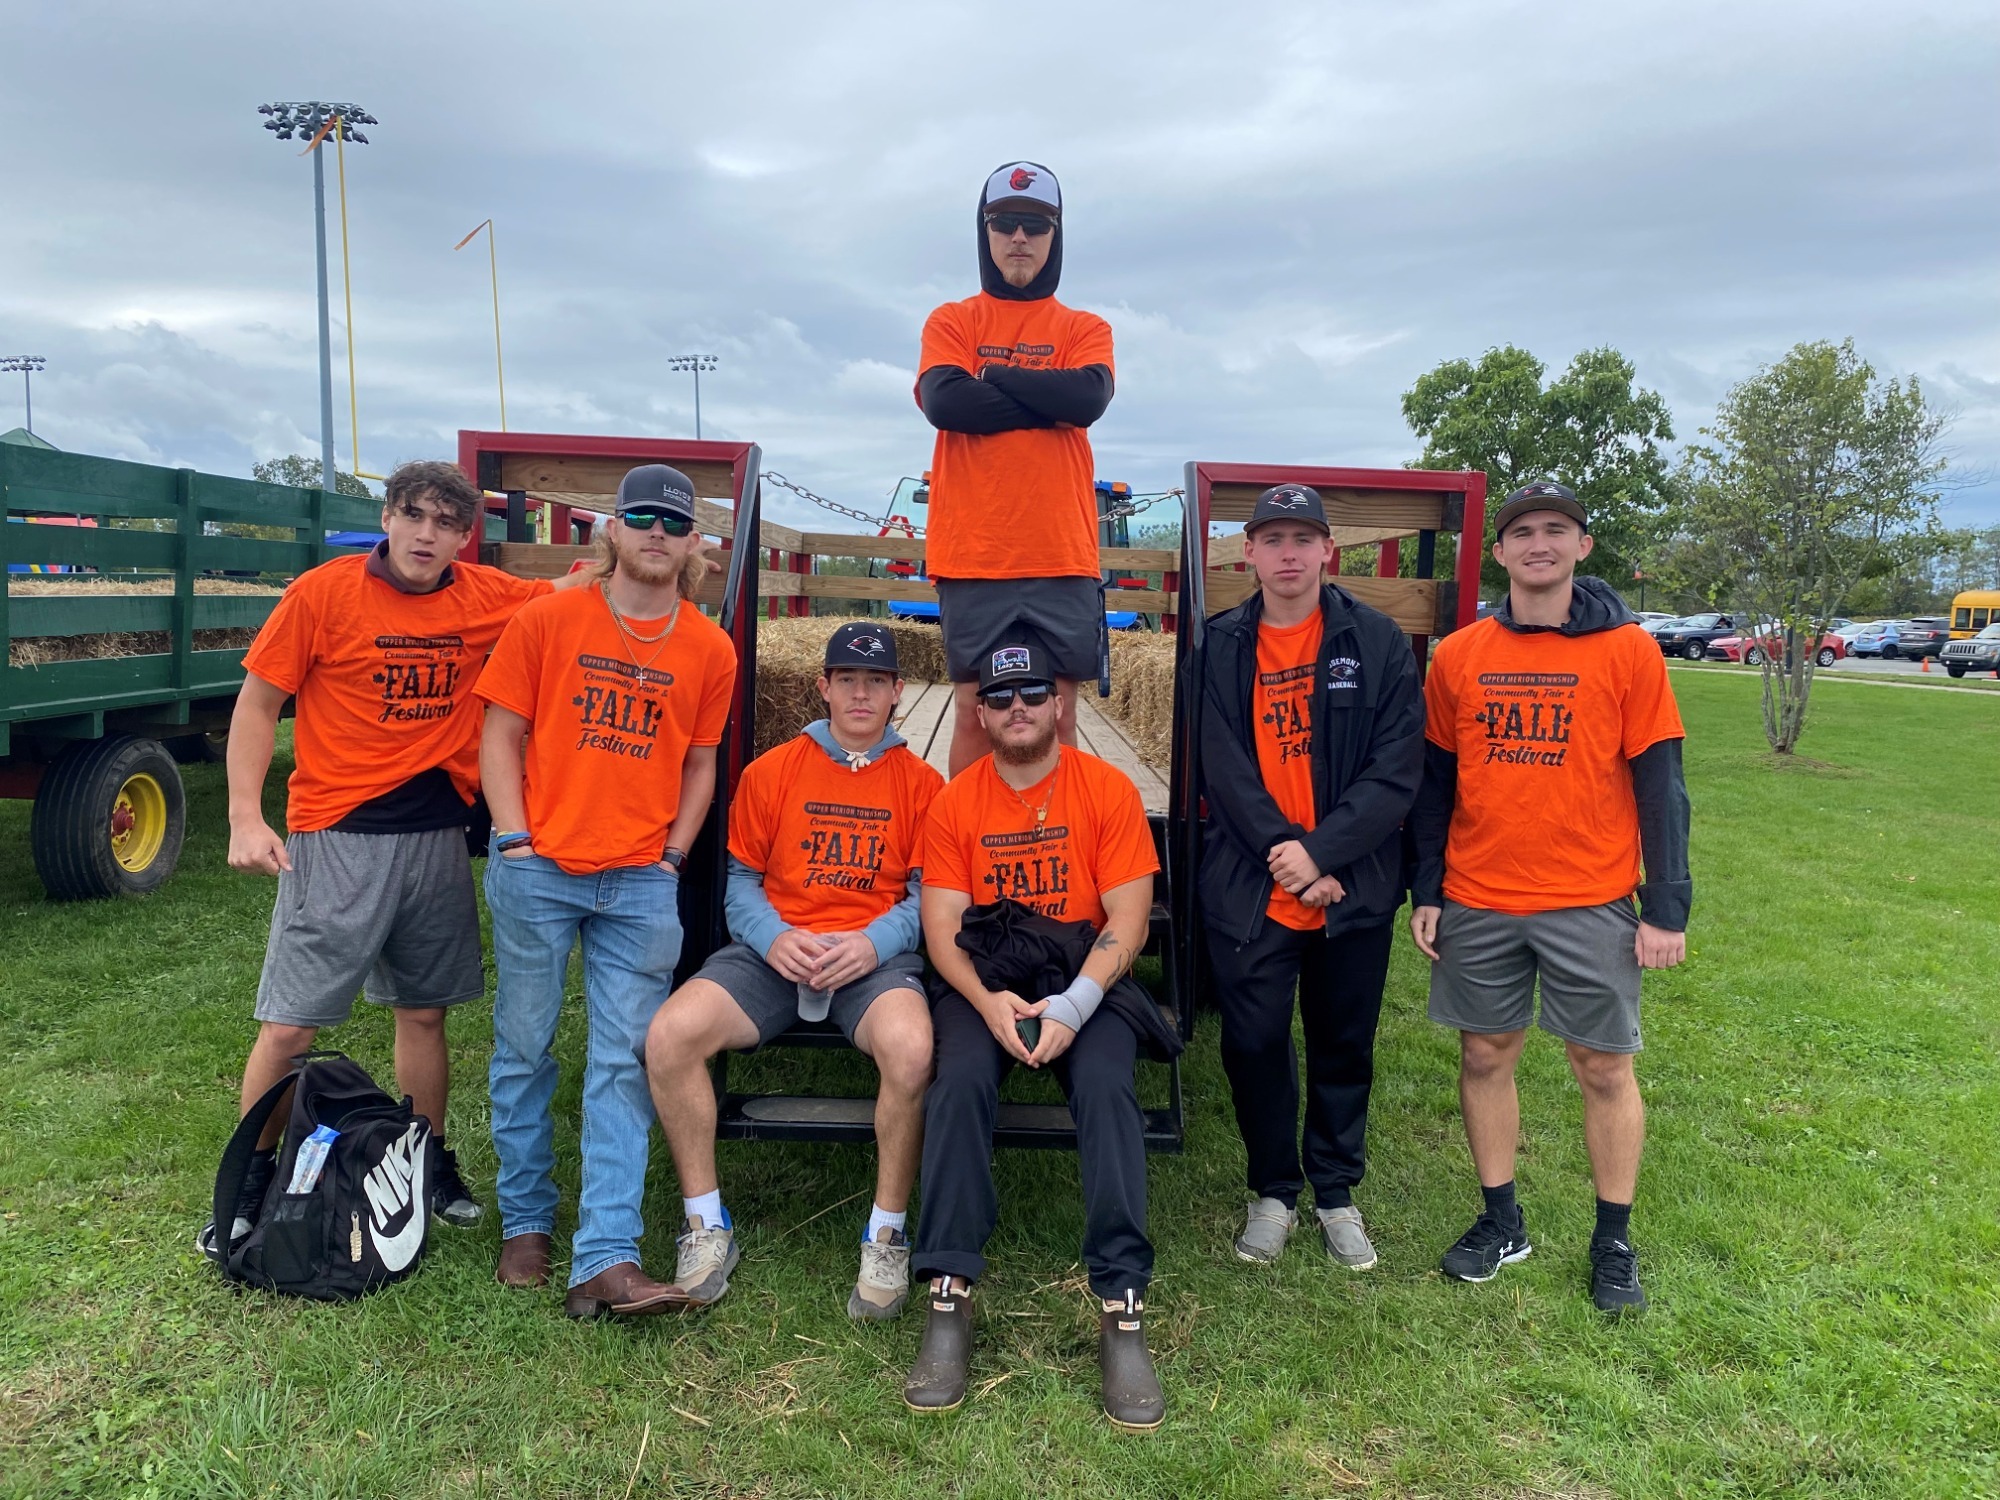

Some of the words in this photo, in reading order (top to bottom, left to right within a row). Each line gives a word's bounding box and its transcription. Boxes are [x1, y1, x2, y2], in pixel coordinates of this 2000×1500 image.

[1020, 344, 1052, 354] TOWNSHIP
[1025, 358, 1043, 366] Fair
[1045, 358, 1051, 366] &
[380, 638, 402, 646] UPPER
[384, 651, 434, 661] Community
[582, 657, 606, 668] UPPER
[634, 668, 671, 682] TWNSHIP
[382, 662, 456, 700] FALL
[584, 670, 633, 690] Community
[638, 683, 659, 694] Fair
[1328, 681, 1358, 689] BASEBALL
[1484, 688, 1538, 699] Community
[1542, 688, 1564, 699] Fair
[1568, 691, 1574, 699] &
[378, 700, 454, 723] Festival
[580, 686, 659, 738] FALL
[1485, 702, 1570, 744] FALL
[576, 728, 654, 760] Festival
[1483, 742, 1567, 767] Festival
[808, 804, 829, 813] UPPER
[830, 806, 855, 816] MERION
[856, 809, 889, 819] TOWNSHIP
[810, 817, 858, 830] Community
[862, 822, 879, 831] Fair
[985, 836, 1006, 844] UPPER
[1008, 834, 1032, 843] MERION
[807, 830, 882, 872] FALL
[990, 847, 1037, 859] Community
[1041, 843, 1058, 853] Fair
[803, 868, 877, 890] Festival
[992, 856, 1068, 899] FALL
[364, 1122, 420, 1231] NIKE
